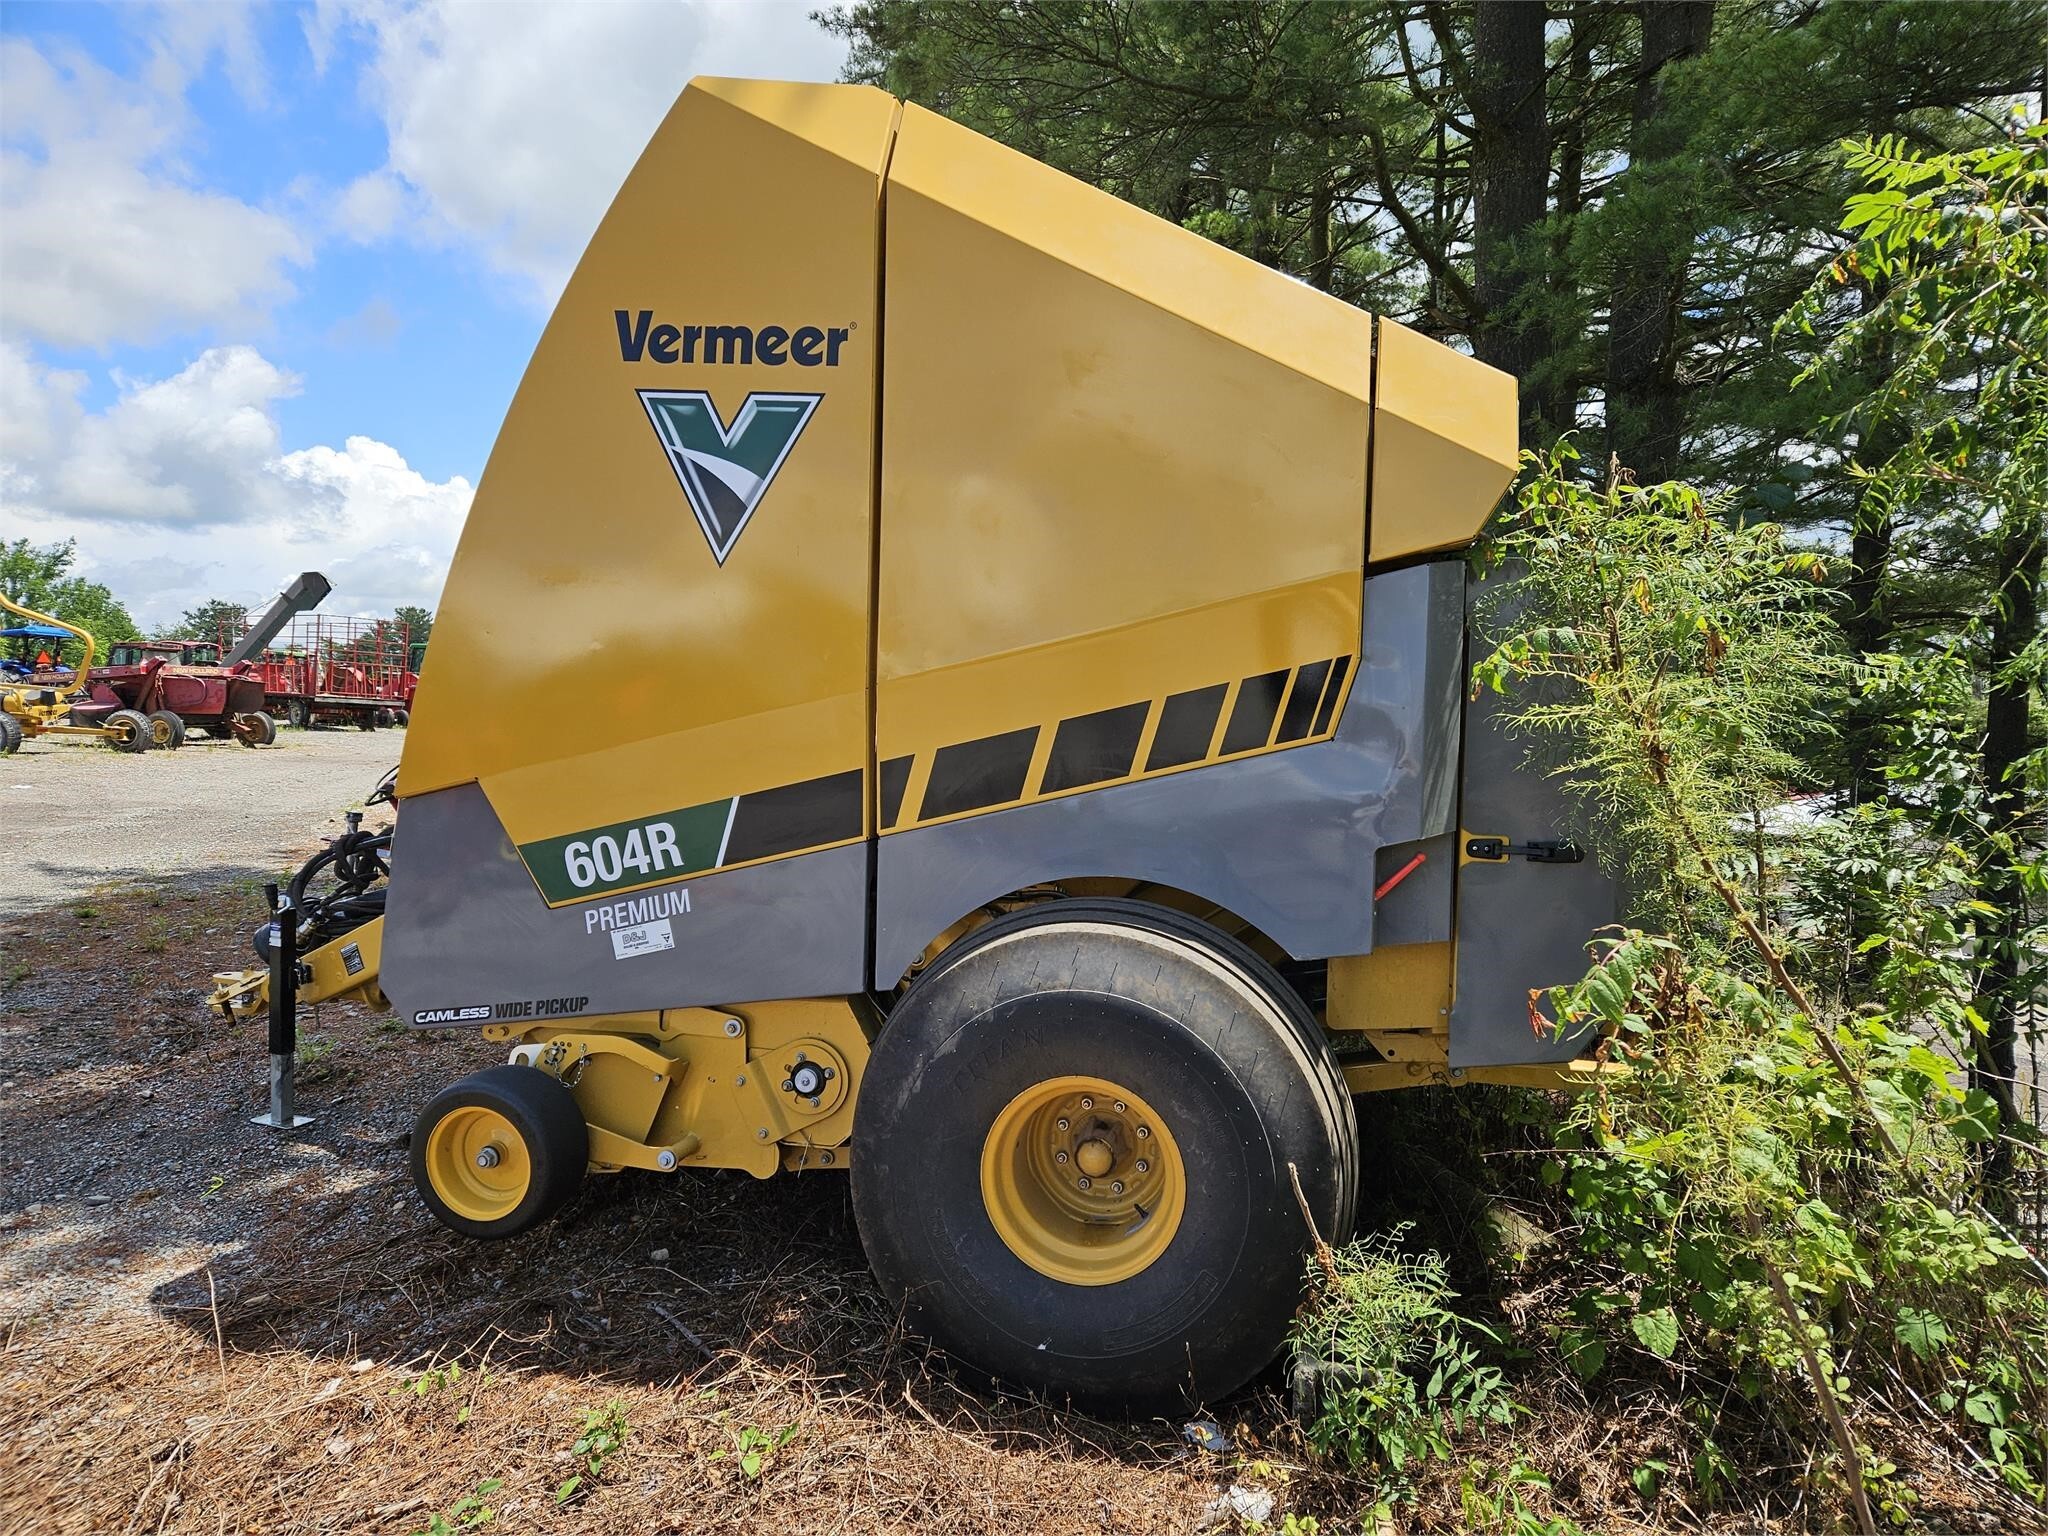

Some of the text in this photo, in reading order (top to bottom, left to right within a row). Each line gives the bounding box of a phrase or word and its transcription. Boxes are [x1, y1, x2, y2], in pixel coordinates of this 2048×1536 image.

[614, 309, 849, 367] Vermeer
[564, 821, 685, 888] 604R
[584, 888, 692, 935] PREMIUM
[622, 930, 647, 945] D&J
[414, 996, 590, 1024] CAMLESS WIDE PICKUP
